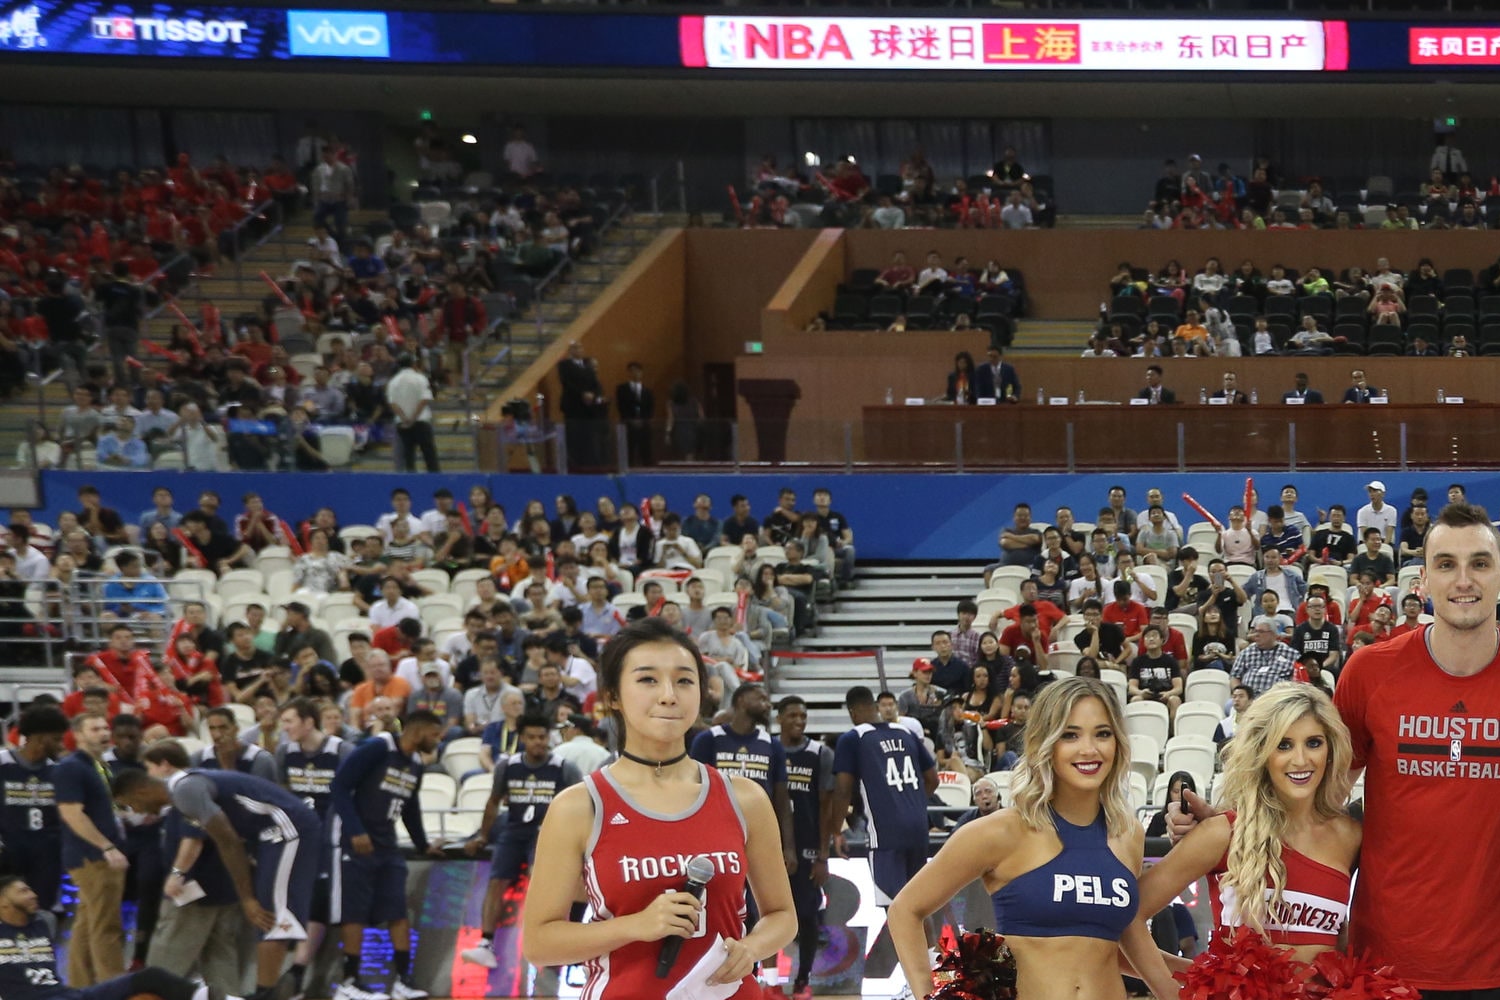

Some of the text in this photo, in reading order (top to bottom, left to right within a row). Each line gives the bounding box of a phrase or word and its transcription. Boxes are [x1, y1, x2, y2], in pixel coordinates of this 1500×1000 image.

[137, 19, 247, 43] TISSOT
[297, 19, 381, 46] vivo
[745, 24, 975, 60] NBA 球迷日
[988, 27, 1077, 62] 上海
[1177, 34, 1308, 59] 东风日产
[1326, 533, 1342, 546] 17
[716, 752, 769, 764] NEW ORLEANS
[880, 739, 905, 753] HILL
[786, 766, 813, 776] LEANS
[886, 755, 919, 792] 44
[618, 851, 741, 883] ROCKTS
[1053, 873, 1131, 908] PELS
